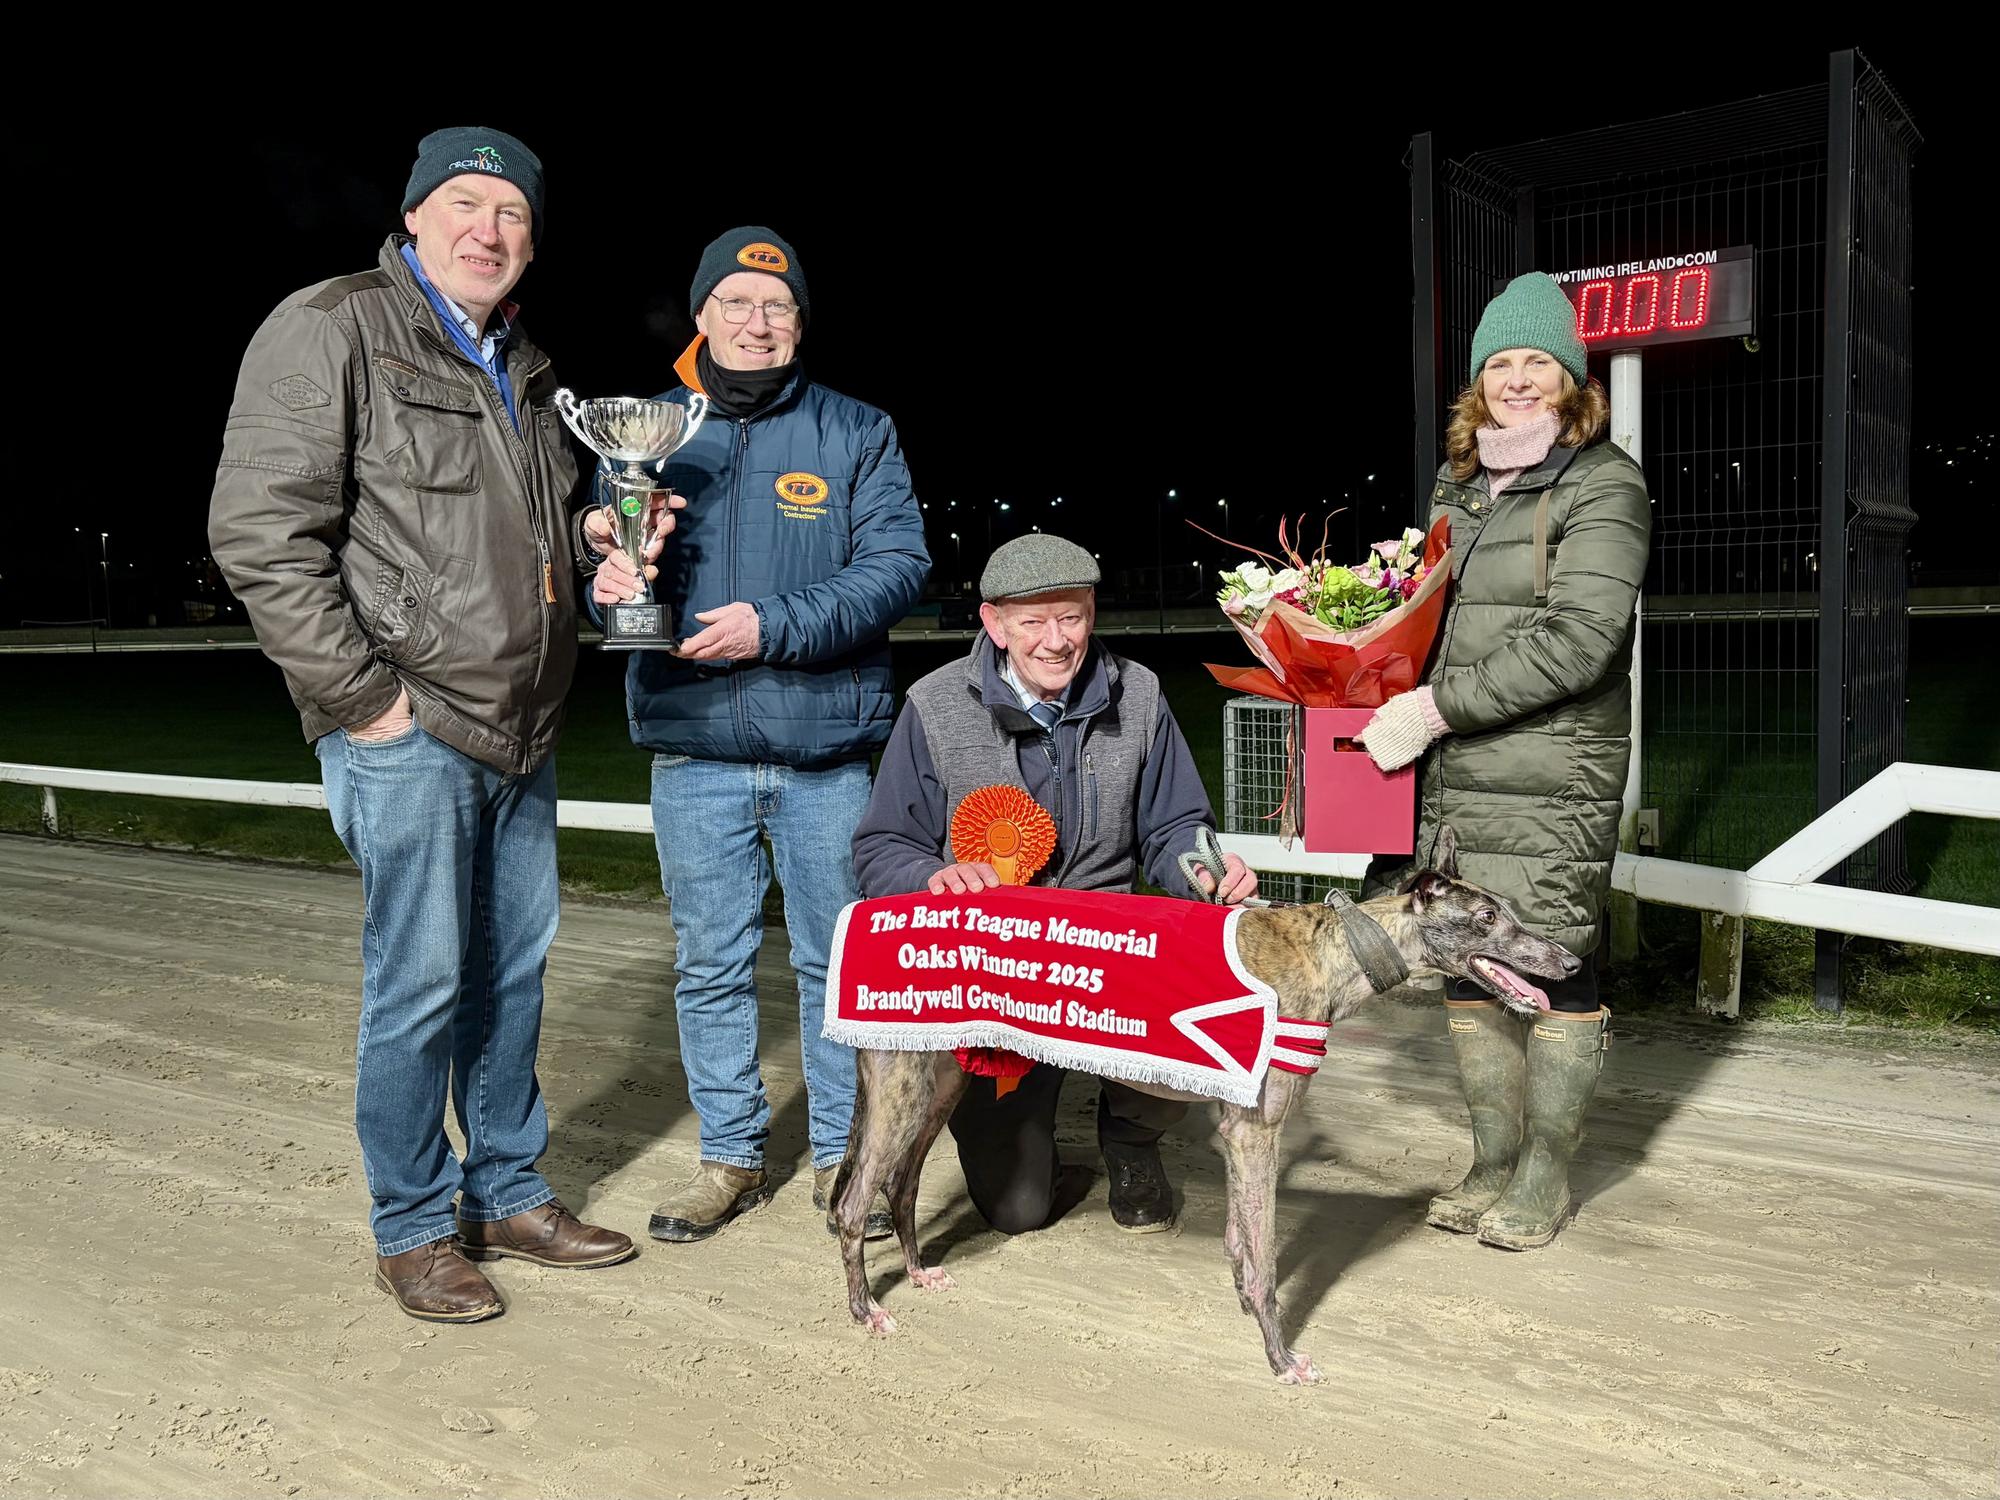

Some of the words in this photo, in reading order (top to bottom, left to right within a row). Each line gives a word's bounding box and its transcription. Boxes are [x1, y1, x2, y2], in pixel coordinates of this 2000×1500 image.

[449, 159, 502, 173] ORCHARD
[1578, 268, 1707, 337] 0.00
[776, 502, 799, 511] Thermal
[800, 505, 827, 515] Insulation
[783, 510, 816, 520] Contractors
[870, 909, 906, 933] The
[910, 906, 960, 929] Bart
[964, 907, 1041, 941] Teague
[1045, 917, 1158, 959] Memorial
[897, 943, 957, 969] Oaks
[958, 945, 1042, 981] Winner
[1045, 962, 1104, 993] 2025
[856, 984, 963, 1016] Brandywell
[966, 985, 1062, 1025] Greyhound
[1065, 1000, 1147, 1037] Stadium
